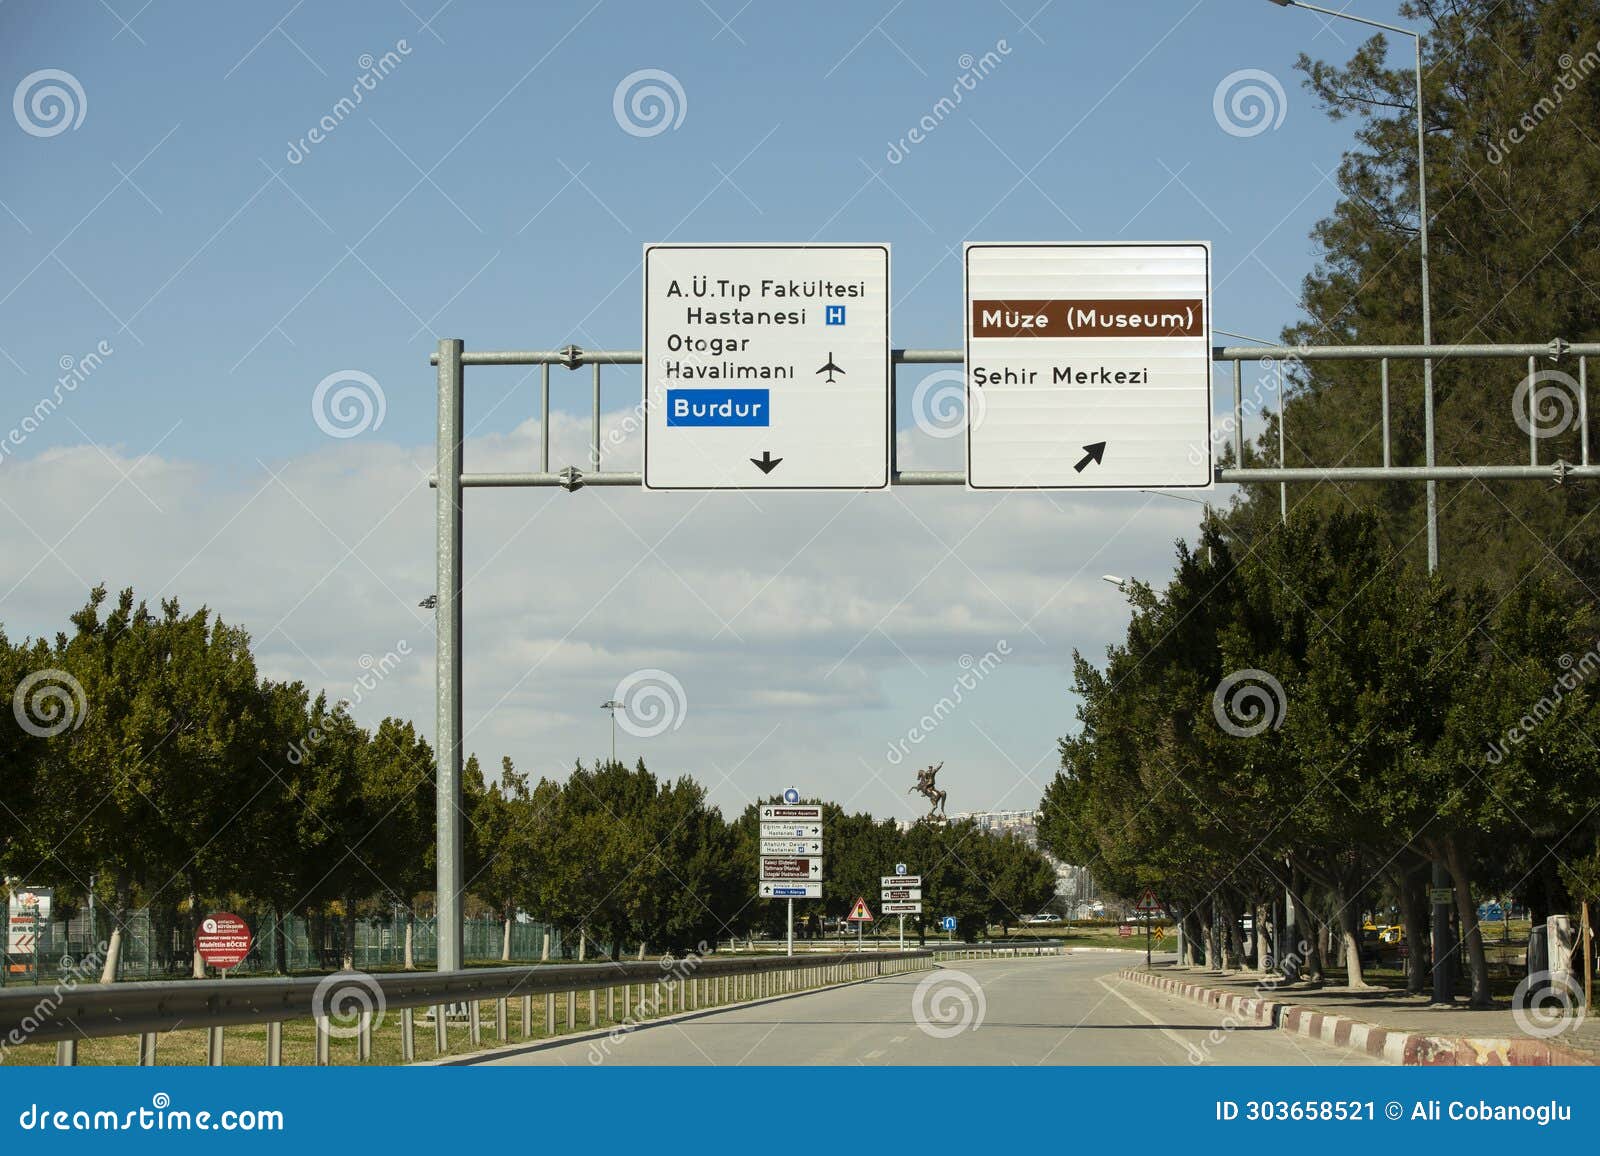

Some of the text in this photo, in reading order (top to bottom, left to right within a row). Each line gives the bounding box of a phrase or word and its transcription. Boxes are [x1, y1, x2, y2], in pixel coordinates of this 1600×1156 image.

[761, 280, 865, 298] Fakültesi
[687, 307, 806, 325] Hastanesi
[982, 306, 1193, 330] Müze (Museum)
[667, 334, 750, 356] Otogar
[666, 361, 794, 379] Havalimanı
[973, 366, 1148, 387] Şehir Merkezi
[674, 399, 761, 417] Burdur
[226, 940, 247, 948] BÖCEK
